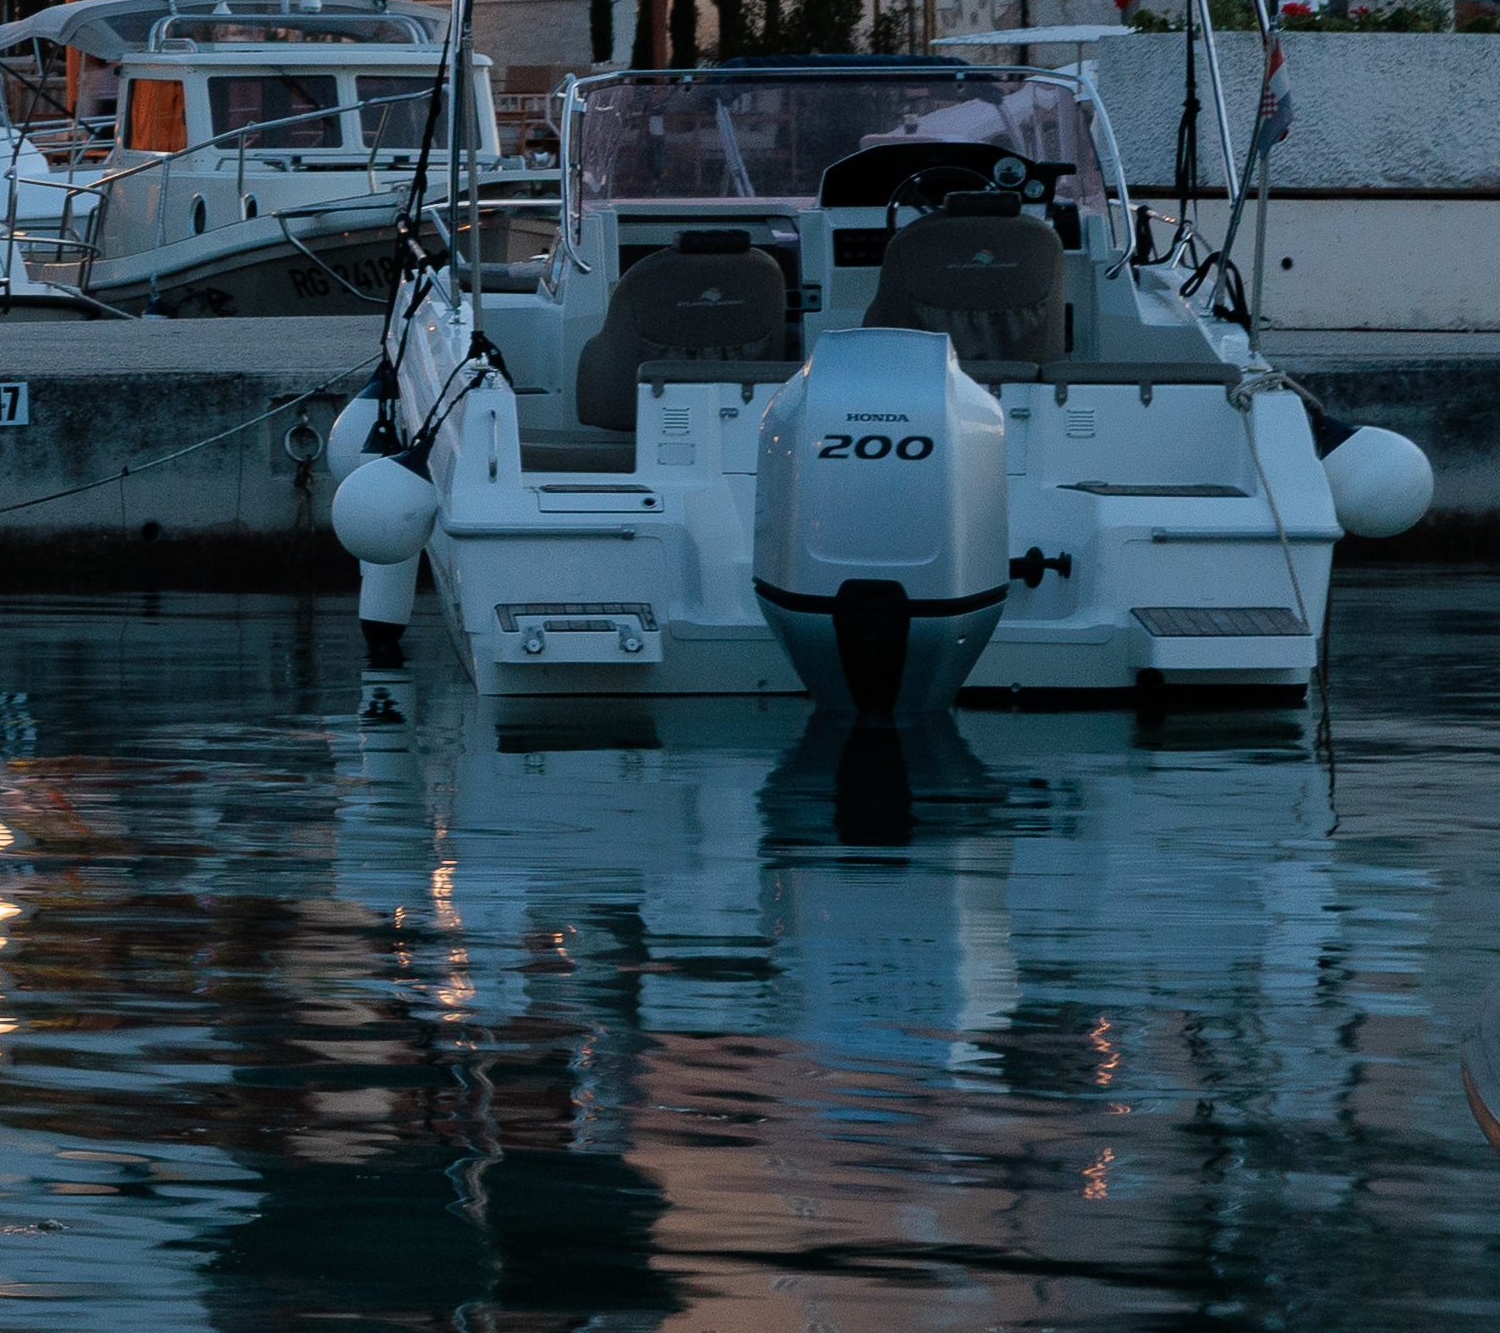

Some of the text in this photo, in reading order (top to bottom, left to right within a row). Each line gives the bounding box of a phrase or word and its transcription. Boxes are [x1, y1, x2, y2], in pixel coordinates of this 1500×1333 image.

[289, 267, 330, 298] RG
[845, 413, 910, 423] HONDA
[818, 435, 935, 460] 200
